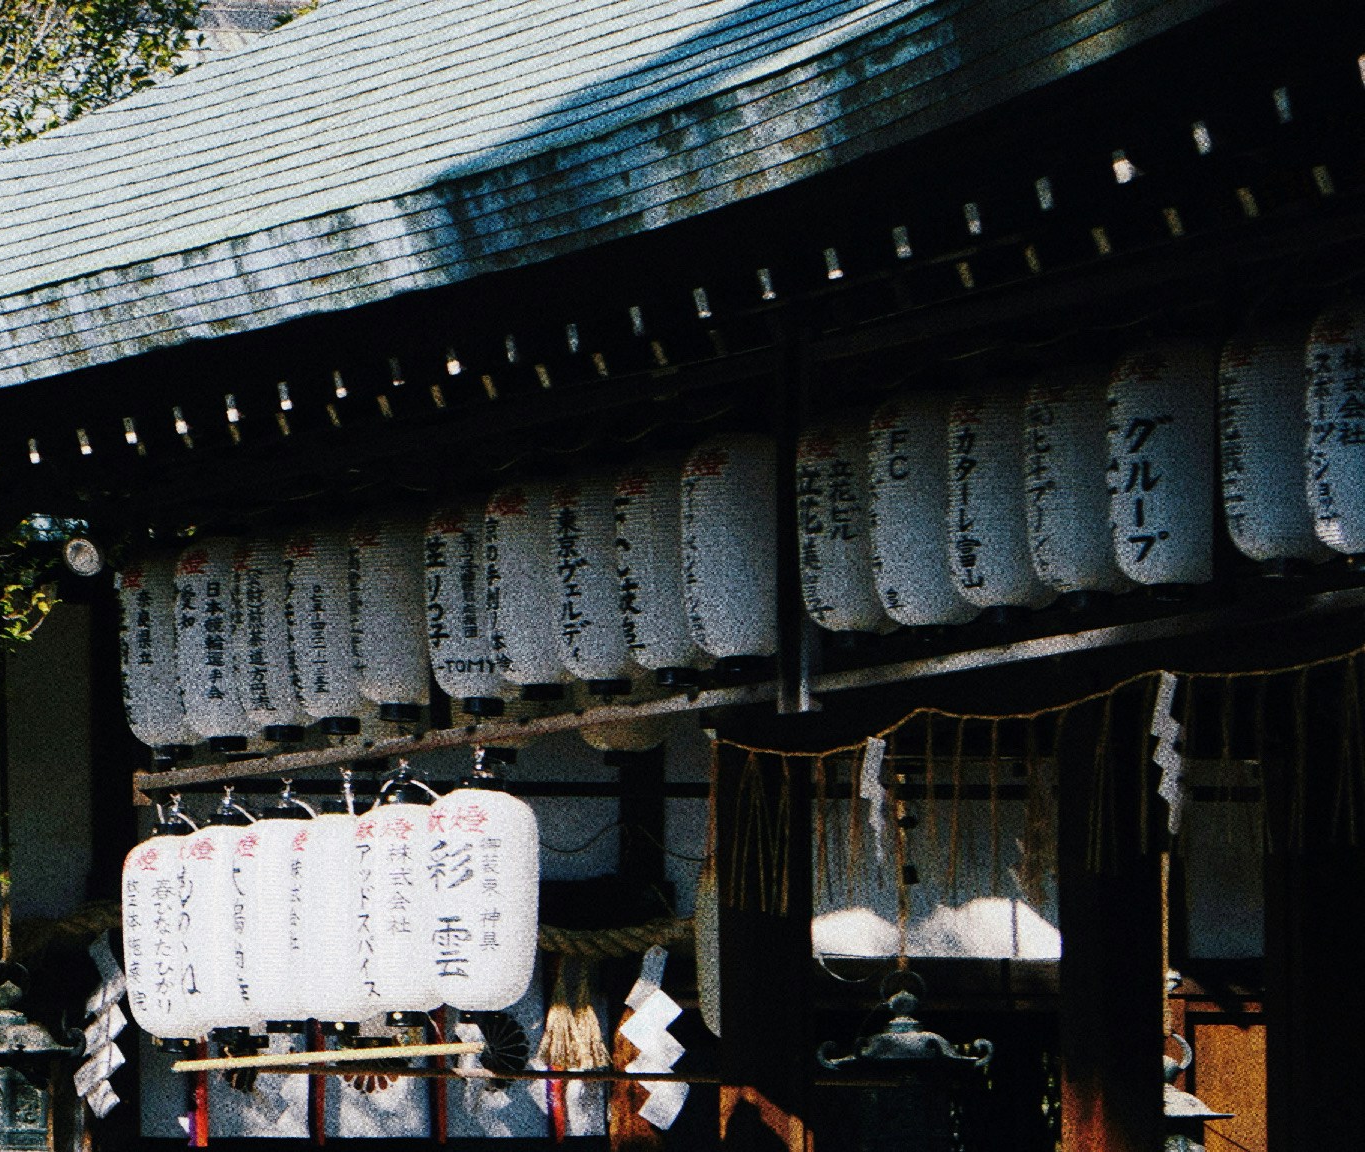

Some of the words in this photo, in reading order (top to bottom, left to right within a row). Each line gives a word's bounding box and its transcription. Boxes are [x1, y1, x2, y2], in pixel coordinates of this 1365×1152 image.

[888, 429, 909, 480] FC
[955, 426, 984, 589] カターレ富山
[1125, 414, 1173, 564] グループ
[556, 506, 589, 662] 東京ヴェルディ
[387, 843, 414, 936] 株式会社
[427, 840, 475, 979] 彩雲
